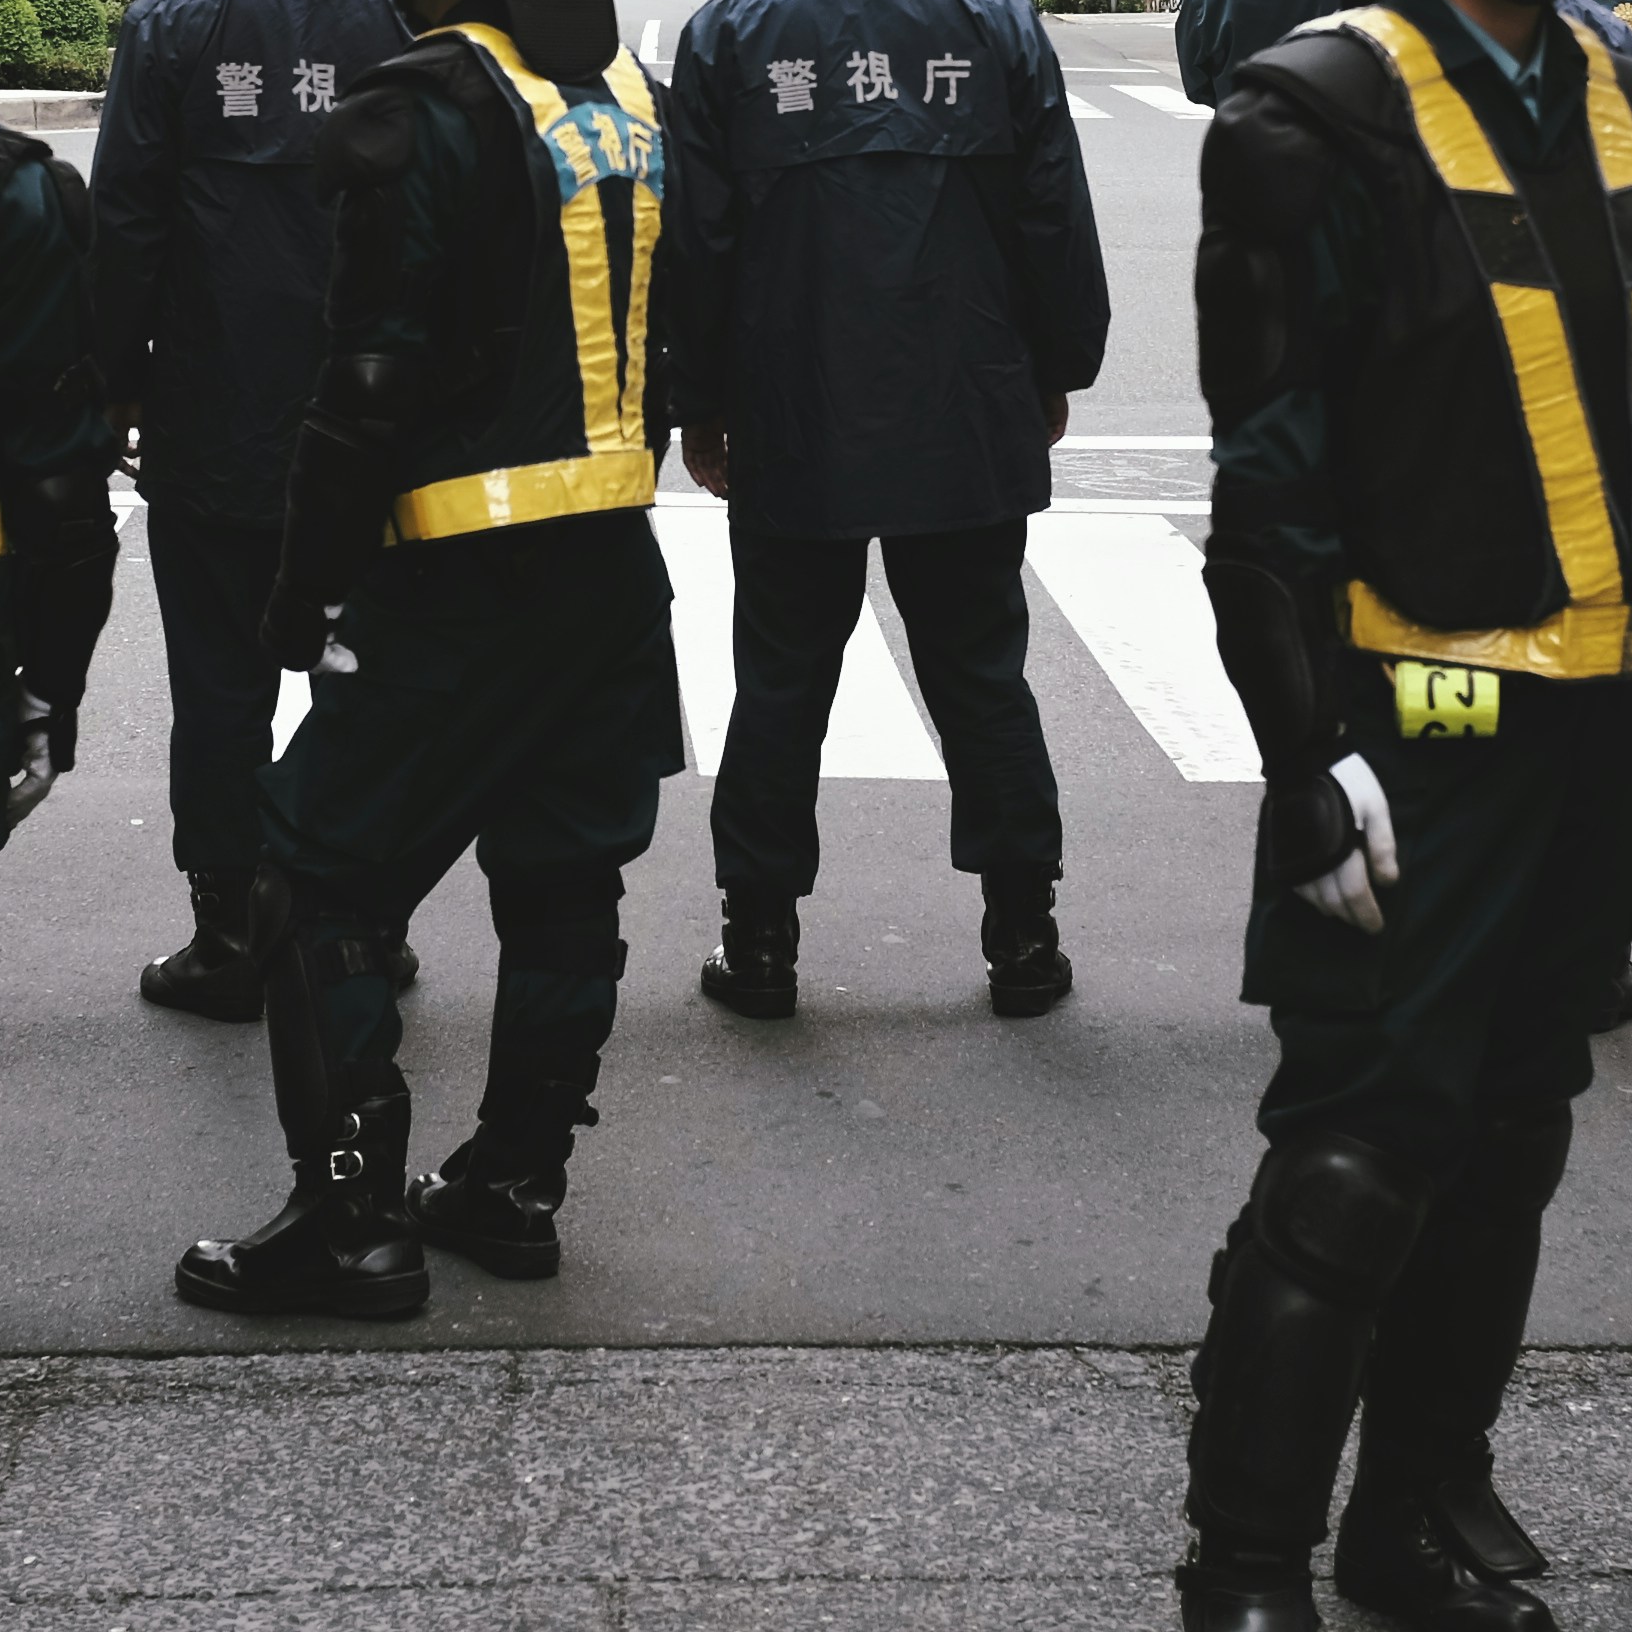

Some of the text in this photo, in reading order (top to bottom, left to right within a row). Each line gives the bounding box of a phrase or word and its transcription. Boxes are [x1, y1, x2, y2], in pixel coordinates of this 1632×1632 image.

[216, 58, 337, 118] 警視
[766, 51, 972, 114] 警視庁
[551, 111, 654, 187] 警視庁
